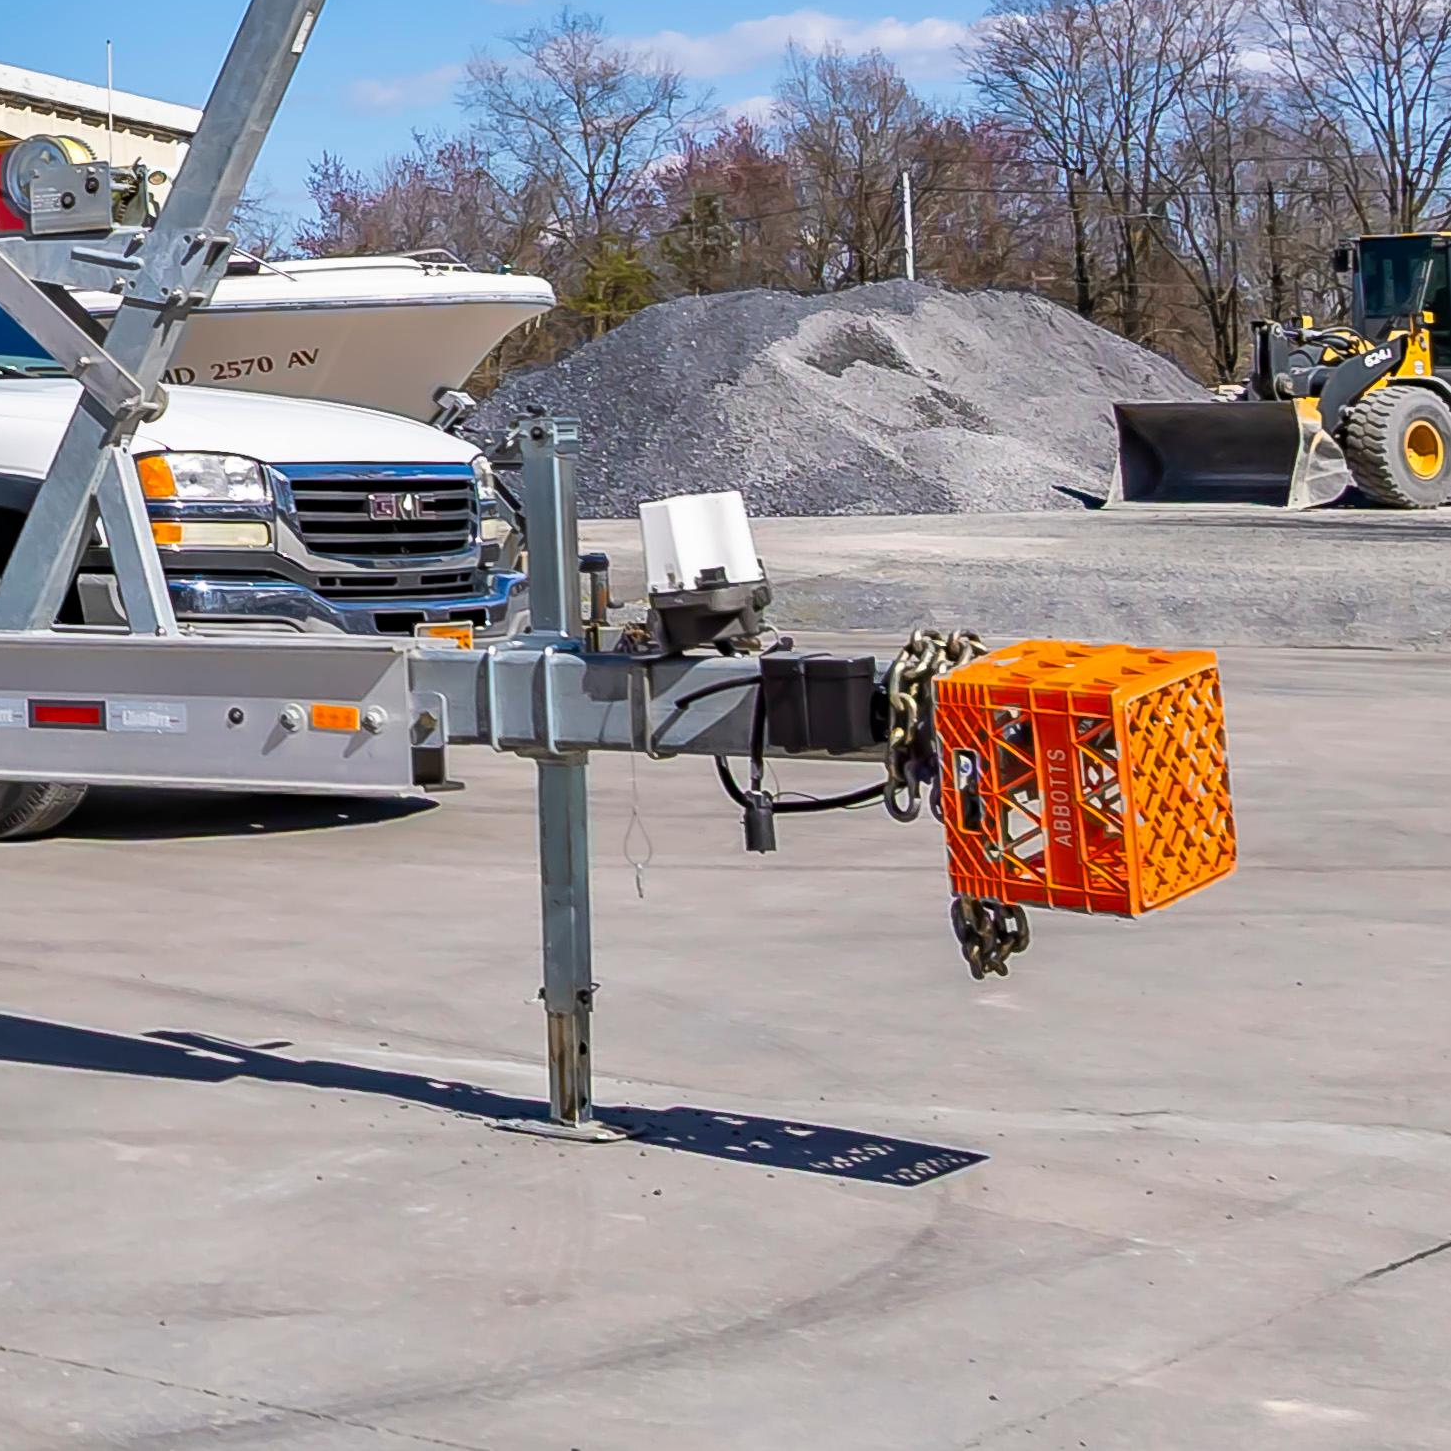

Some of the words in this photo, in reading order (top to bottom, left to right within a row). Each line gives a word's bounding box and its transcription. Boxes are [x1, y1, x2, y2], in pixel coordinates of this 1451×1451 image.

[210, 356, 273, 380] 2570
[287, 348, 319, 368] AV
[368, 492, 438, 521] GMC
[1047, 749, 1073, 847] ABBOTTS
